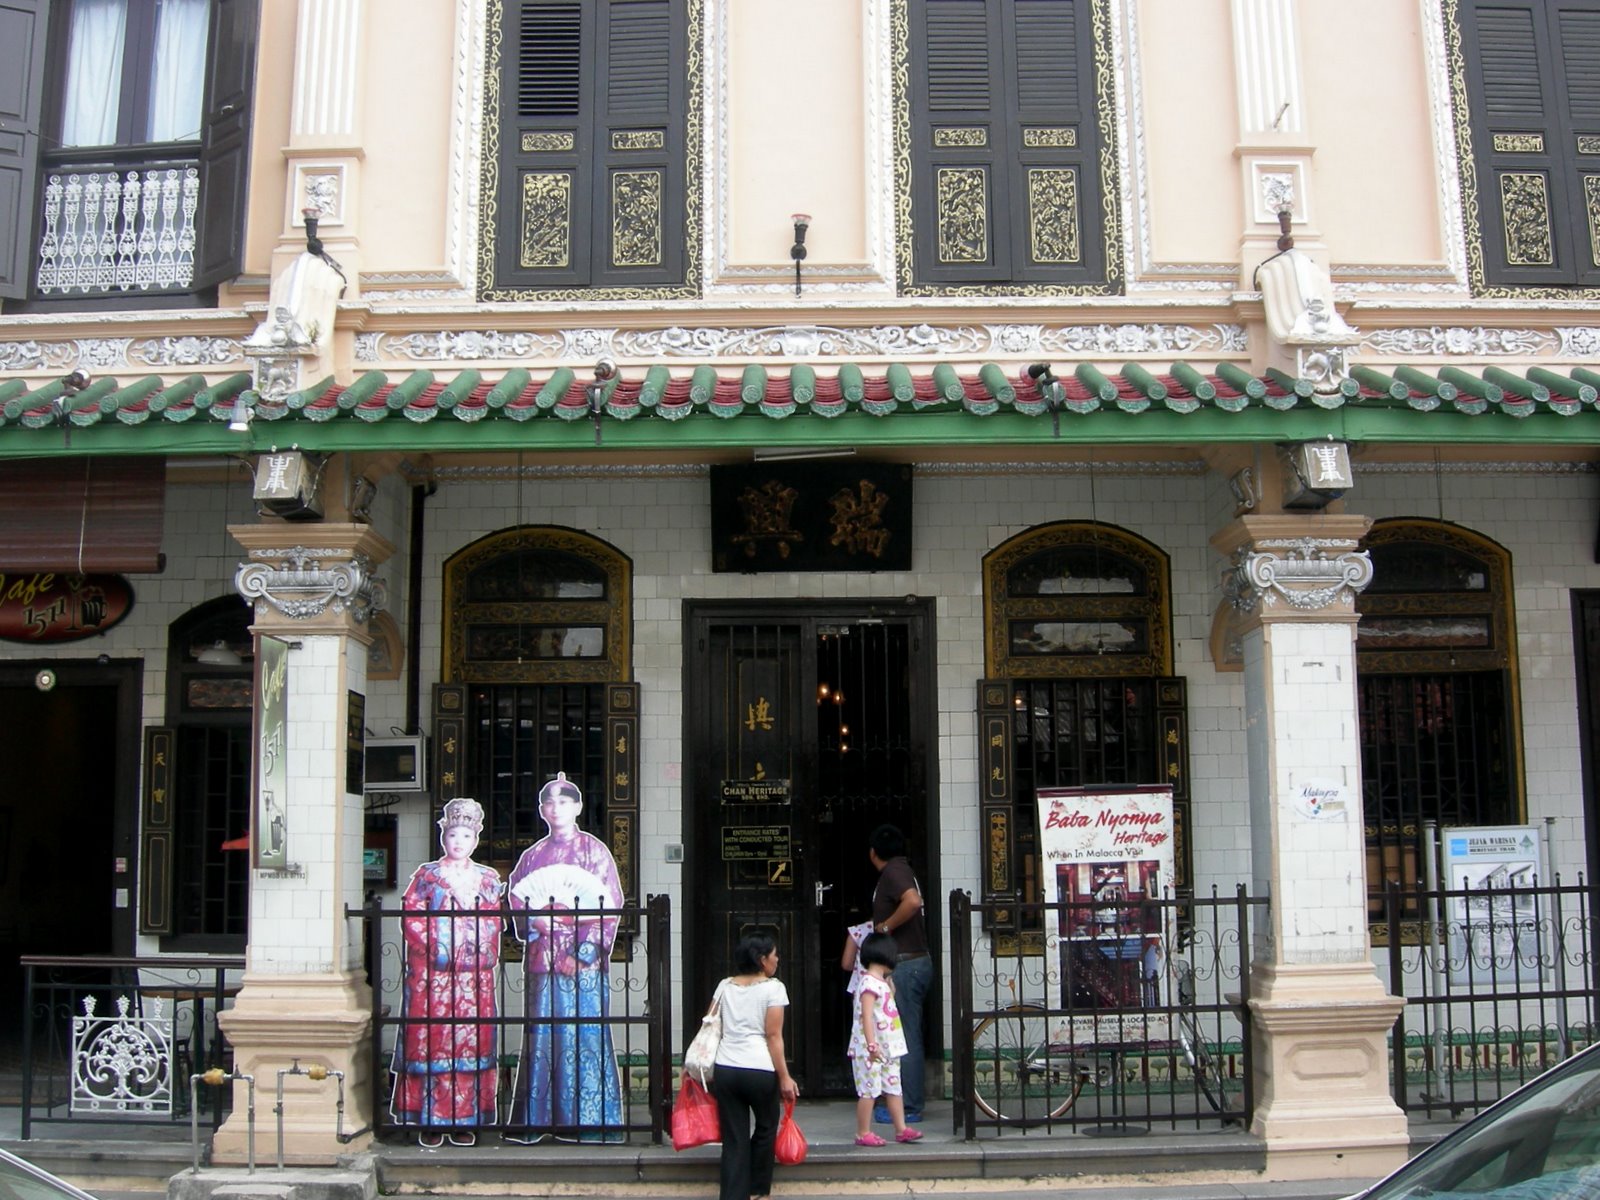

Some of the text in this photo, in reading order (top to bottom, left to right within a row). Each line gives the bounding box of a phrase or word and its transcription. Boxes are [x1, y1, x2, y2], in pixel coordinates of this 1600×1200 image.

[23, 596, 66, 637] 1511
[261, 720, 284, 777] 1511
[723, 786, 788, 796] CHAN HERITAGE
[1045, 808, 1166, 834] Baba Nyonya
[1112, 830, 1170, 847] Heritage
[1047, 850, 1073, 859] When
[1075, 850, 1088, 858] In
[1091, 849, 1124, 858] Malacca
[1126, 1015, 1155, 1024] LOCAED
